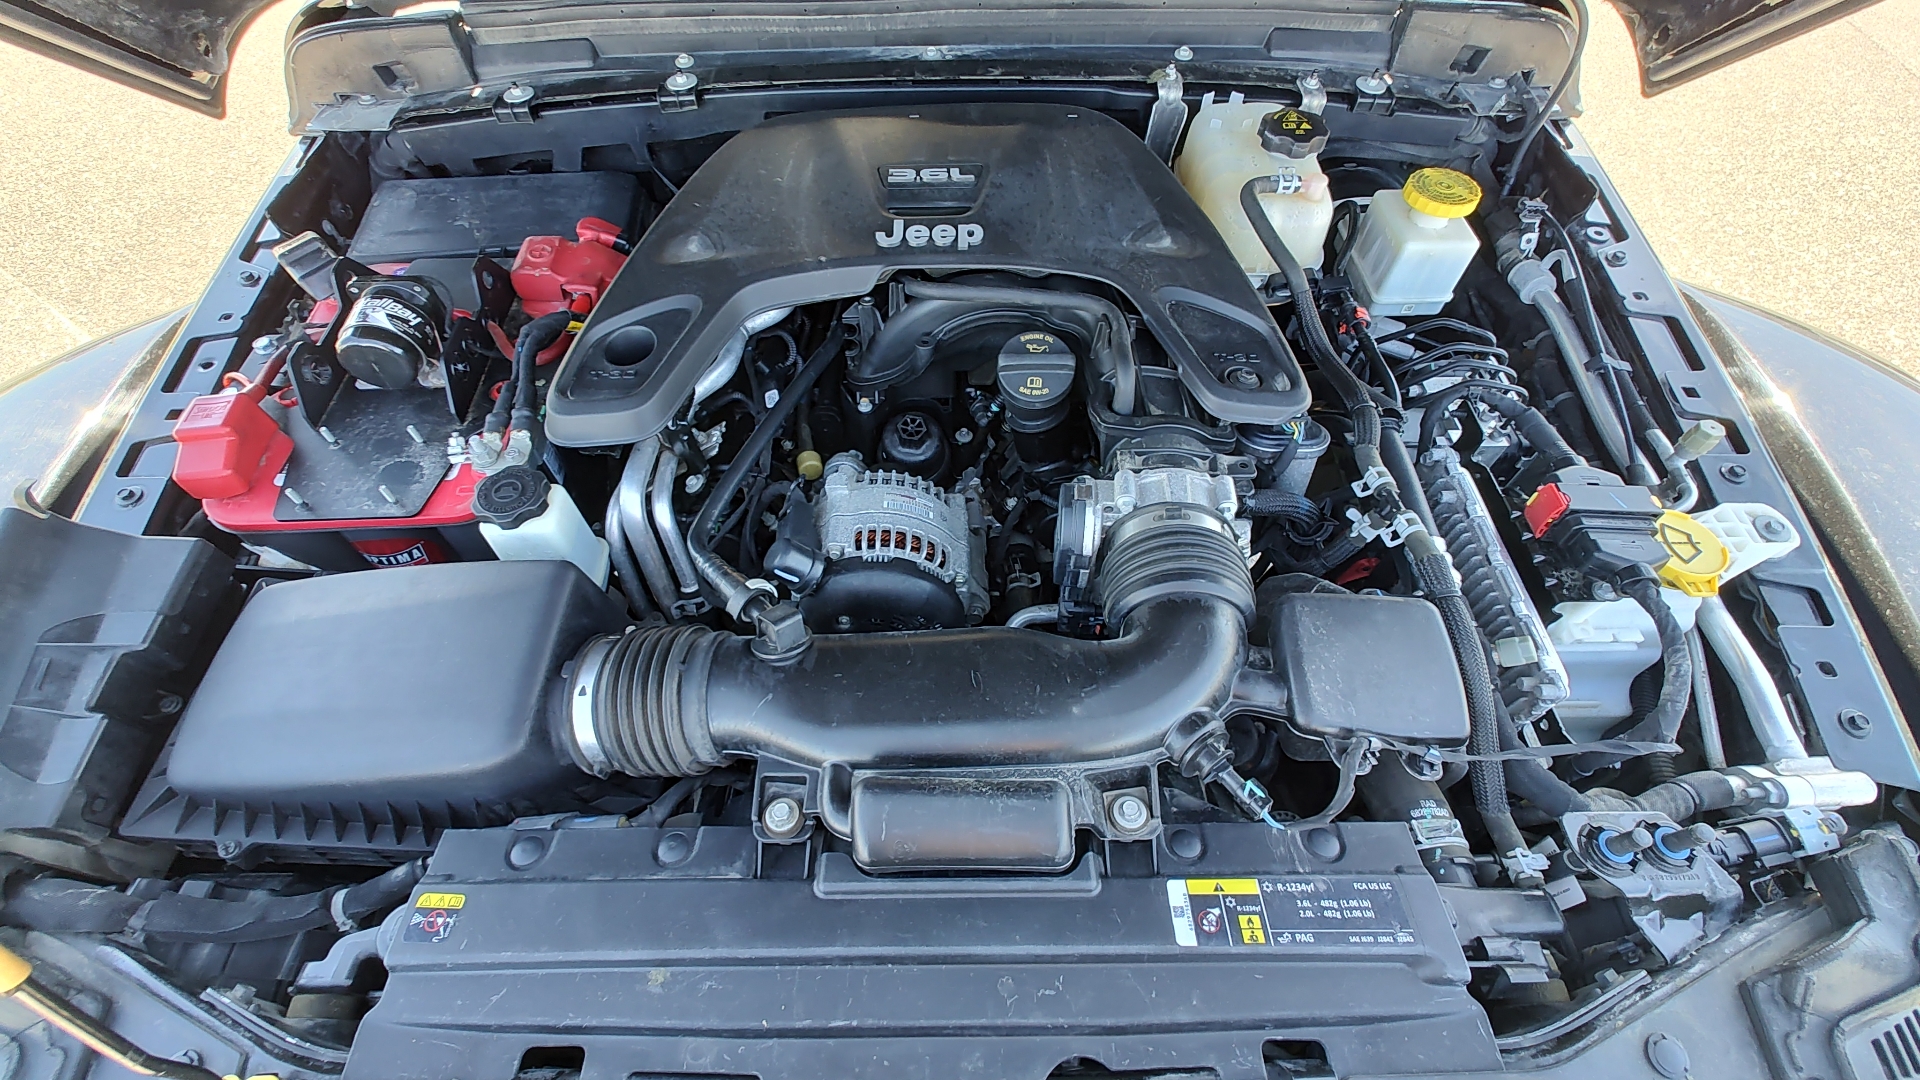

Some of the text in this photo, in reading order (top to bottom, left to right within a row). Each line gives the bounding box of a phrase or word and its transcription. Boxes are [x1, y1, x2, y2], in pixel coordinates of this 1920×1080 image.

[887, 167, 975, 183] 3.6L
[875, 219, 984, 251] Jeep
[362, 297, 424, 326] tallBay
[1020, 333, 1054, 343] ENGINE OIL
[1019, 386, 1031, 395] SAE
[1419, 799, 1437, 808] RAD
[1276, 882, 1316, 893] R-1234yf
[1353, 882, 1392, 890] FCA US LLC
[1296, 899, 1312, 908] 3.6L
[1340, 899, 1359, 908] (1.06
[1360, 899, 1372, 909] Lb)
[1299, 910, 1315, 918] 2.0L
[1344, 910, 1362, 918] (1.06
[1363, 910, 1375, 919] Lb)
[1295, 933, 1315, 942] PAG
